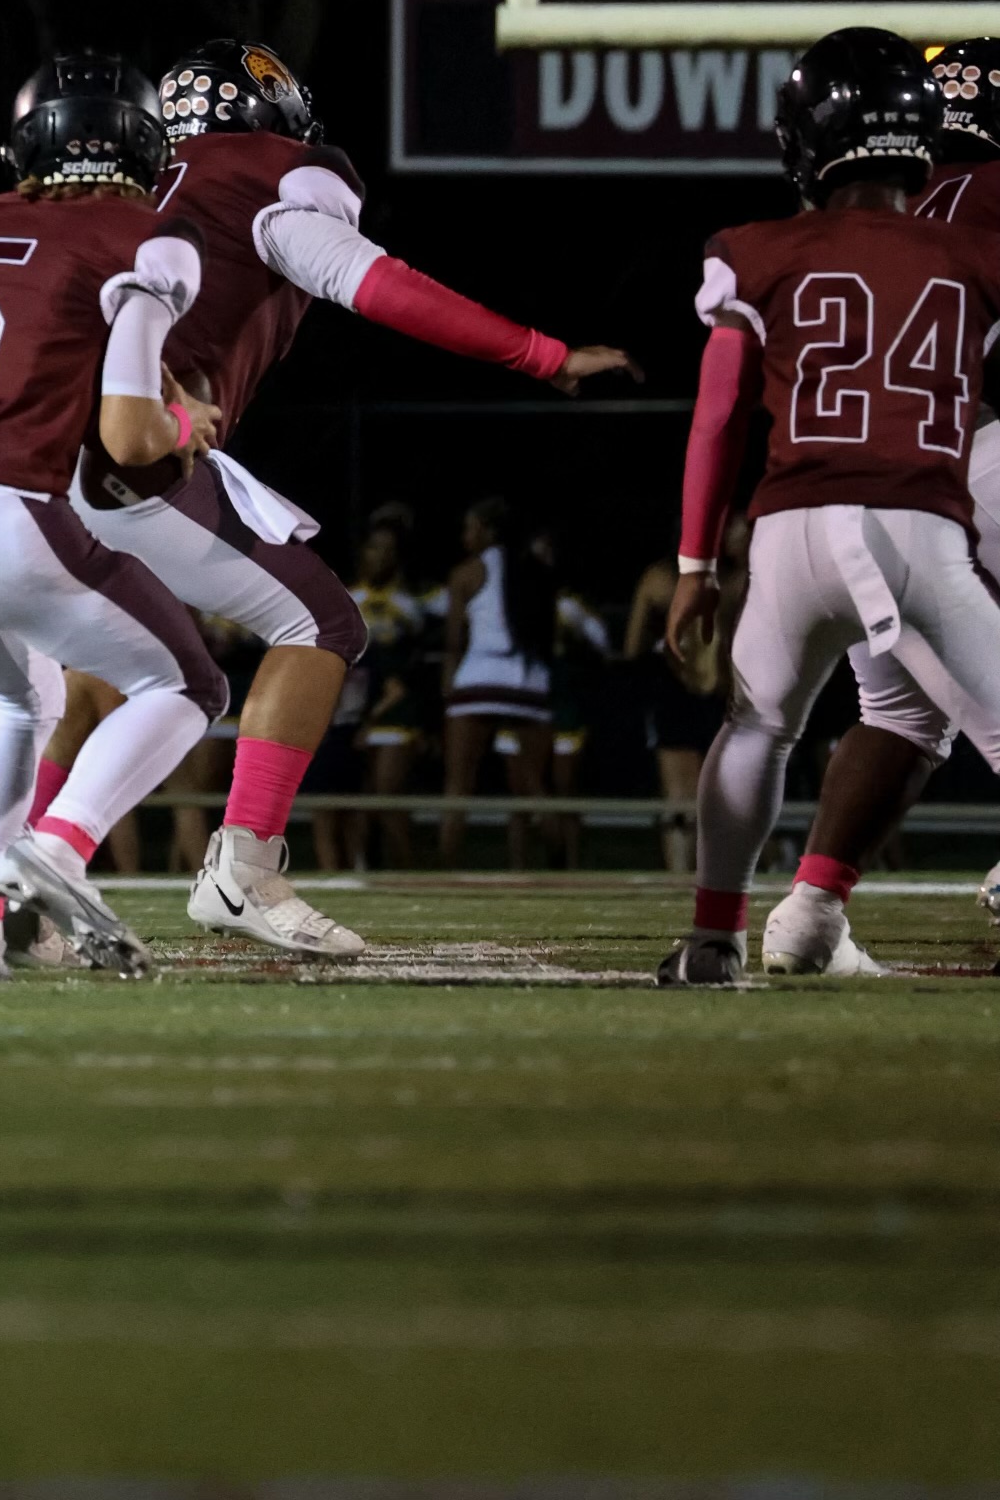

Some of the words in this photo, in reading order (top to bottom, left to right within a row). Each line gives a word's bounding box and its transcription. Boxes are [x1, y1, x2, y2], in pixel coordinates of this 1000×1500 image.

[166, 118, 207, 137] schutt
[866, 132, 919, 148] schutt
[62, 159, 117, 174] schutt
[791, 273, 969, 457] 24
